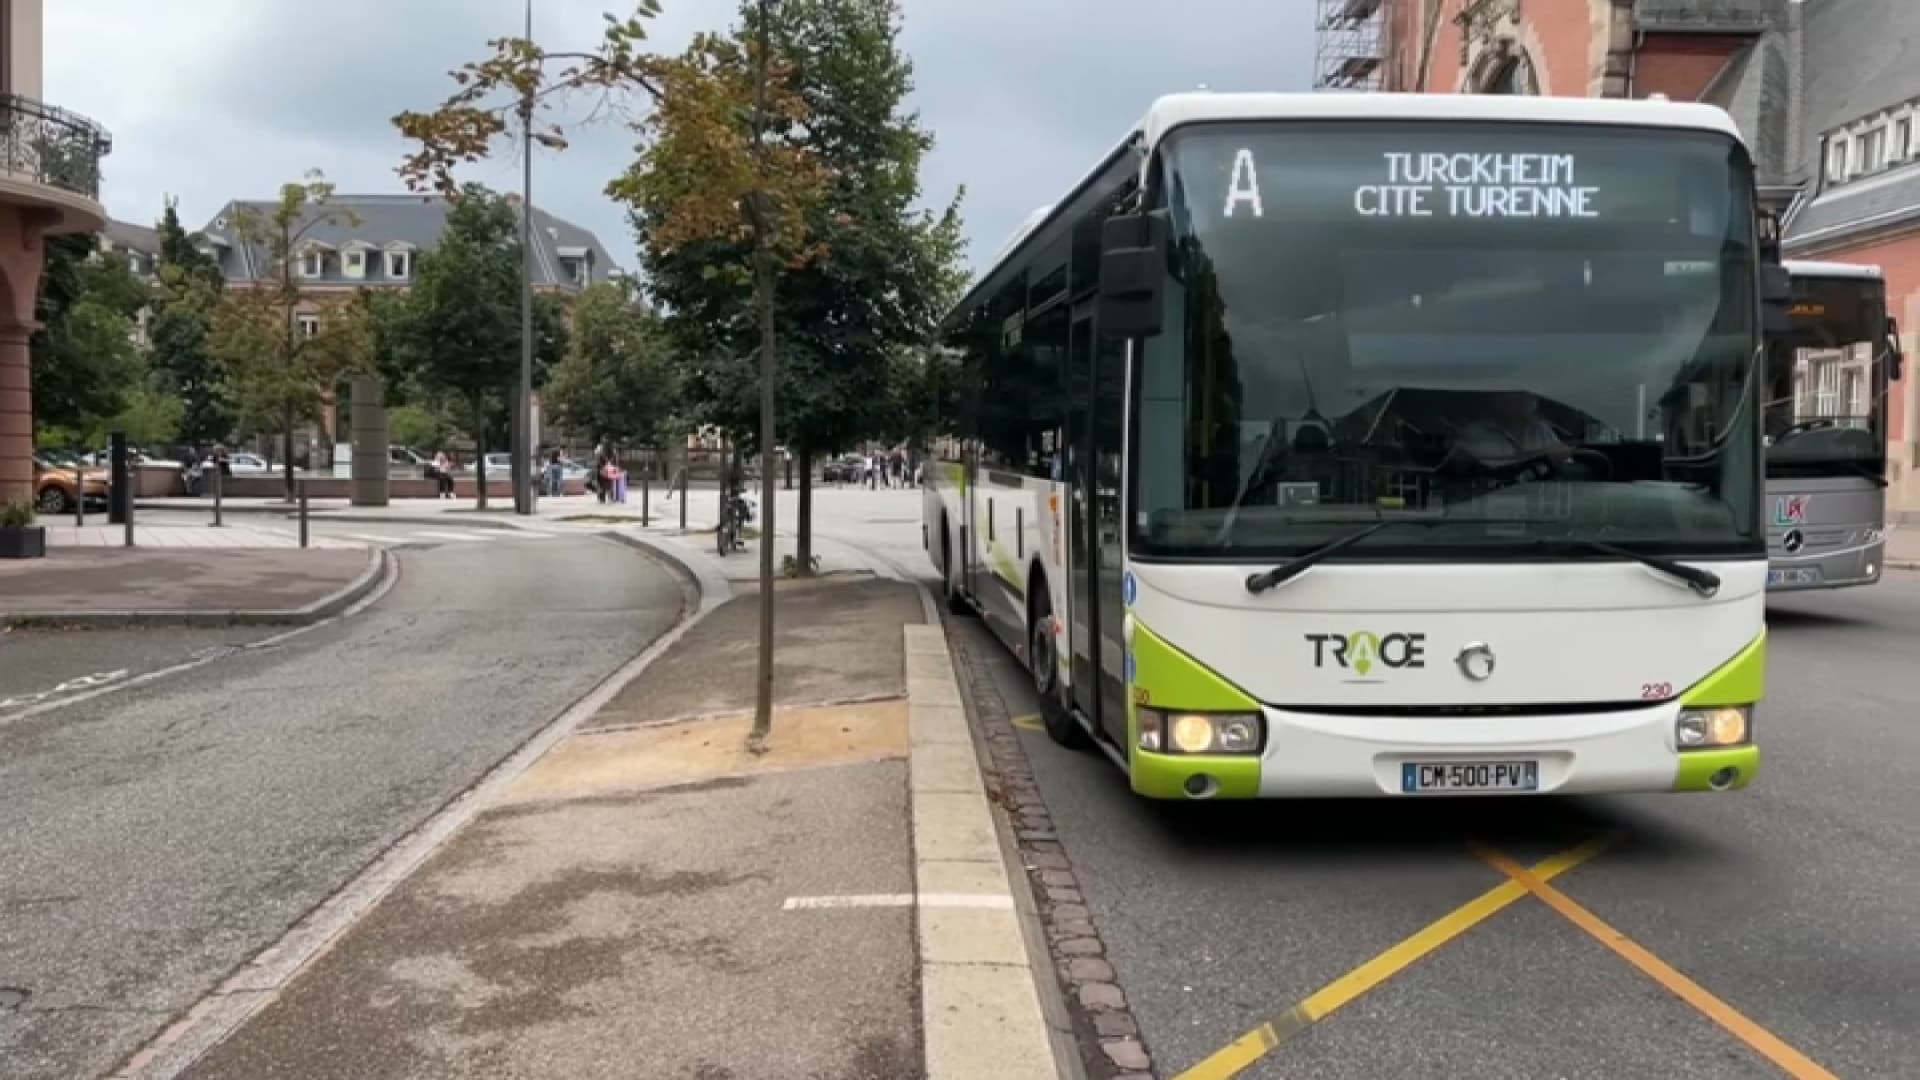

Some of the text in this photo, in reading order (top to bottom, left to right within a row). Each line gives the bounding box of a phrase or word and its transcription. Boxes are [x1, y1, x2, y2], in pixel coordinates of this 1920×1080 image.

[1223, 148, 1264, 218] A
[1383, 152, 1574, 184] TURCKHEIM
[1354, 185, 1600, 217] CITE TURENNE
